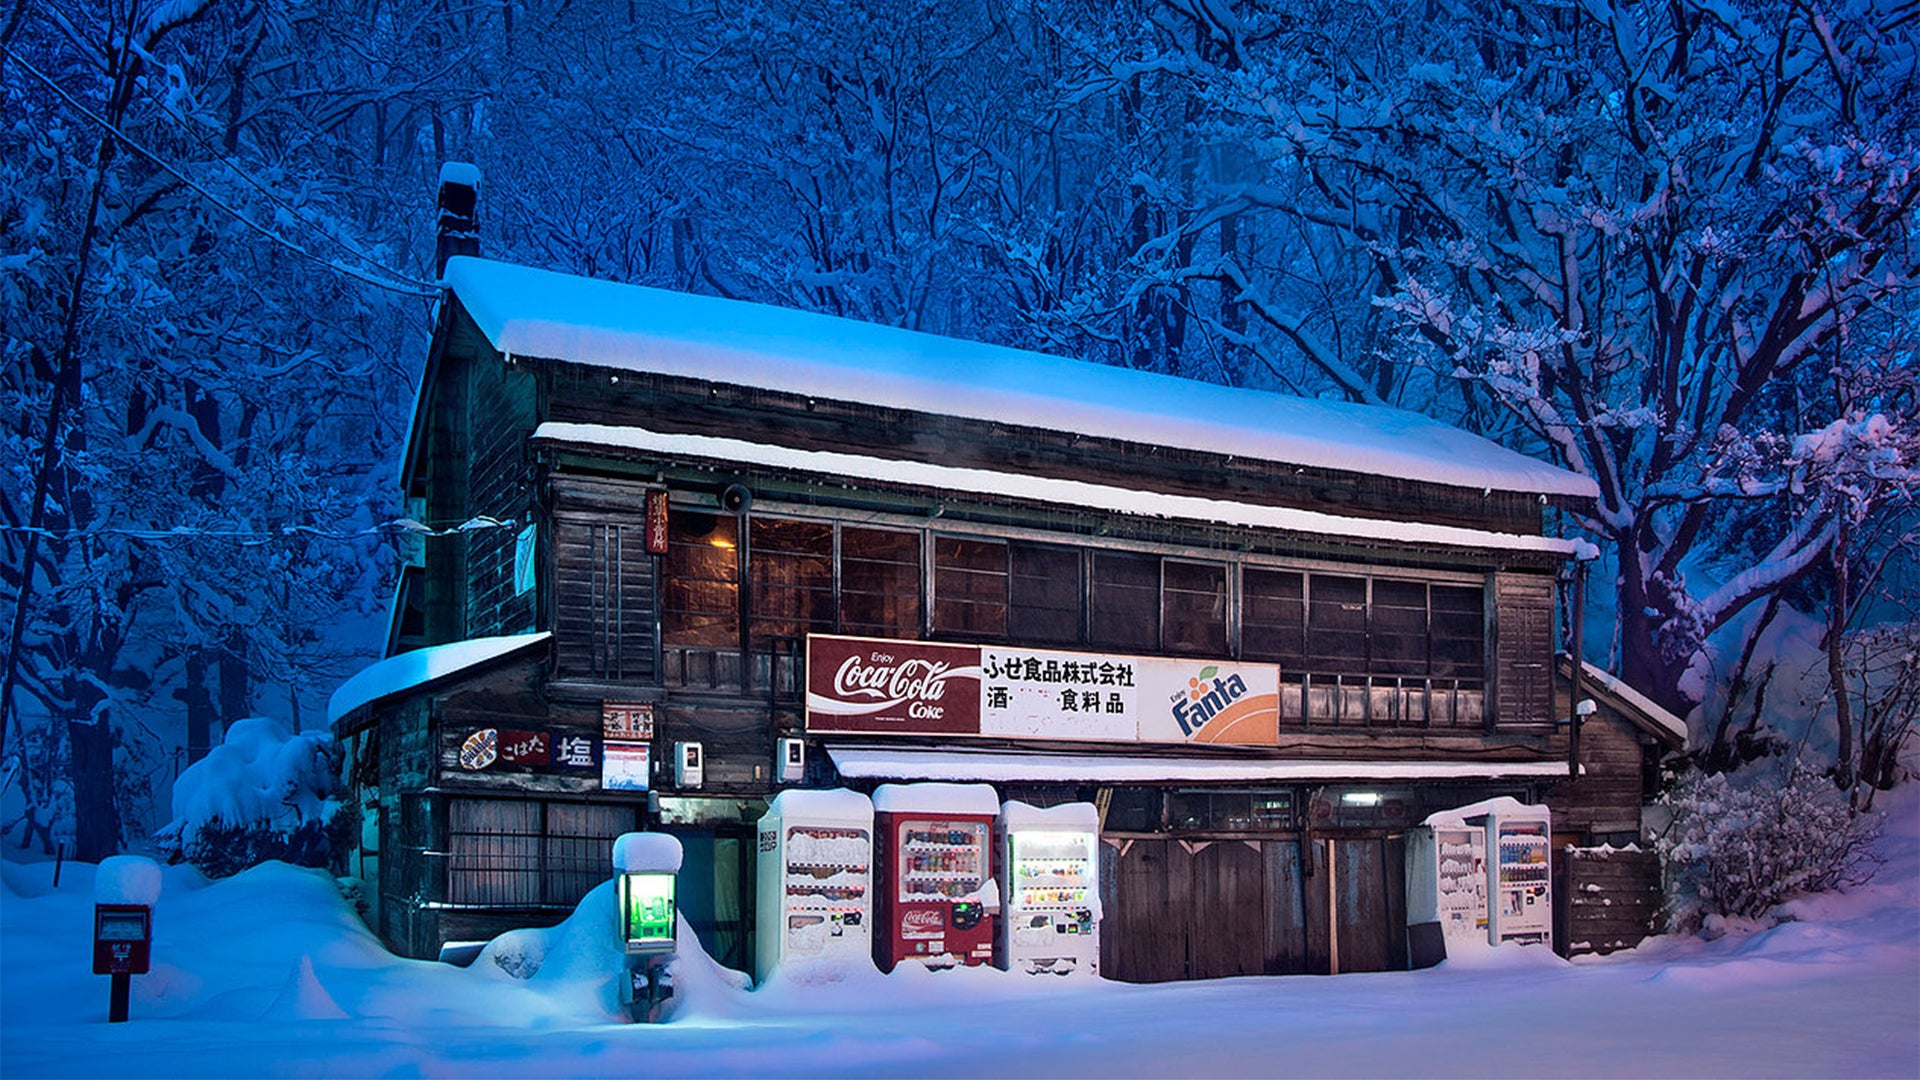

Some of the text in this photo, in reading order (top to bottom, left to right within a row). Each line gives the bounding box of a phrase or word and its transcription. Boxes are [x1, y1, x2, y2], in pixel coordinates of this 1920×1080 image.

[870, 651, 895, 664] Enjoy
[983, 653, 1135, 688] ふせ食品株式会社
[834, 655, 951, 701] Coca-Cola
[908, 701, 945, 720] Coke
[1172, 673, 1247, 737] Fanta
[556, 736, 595, 766] 塩
